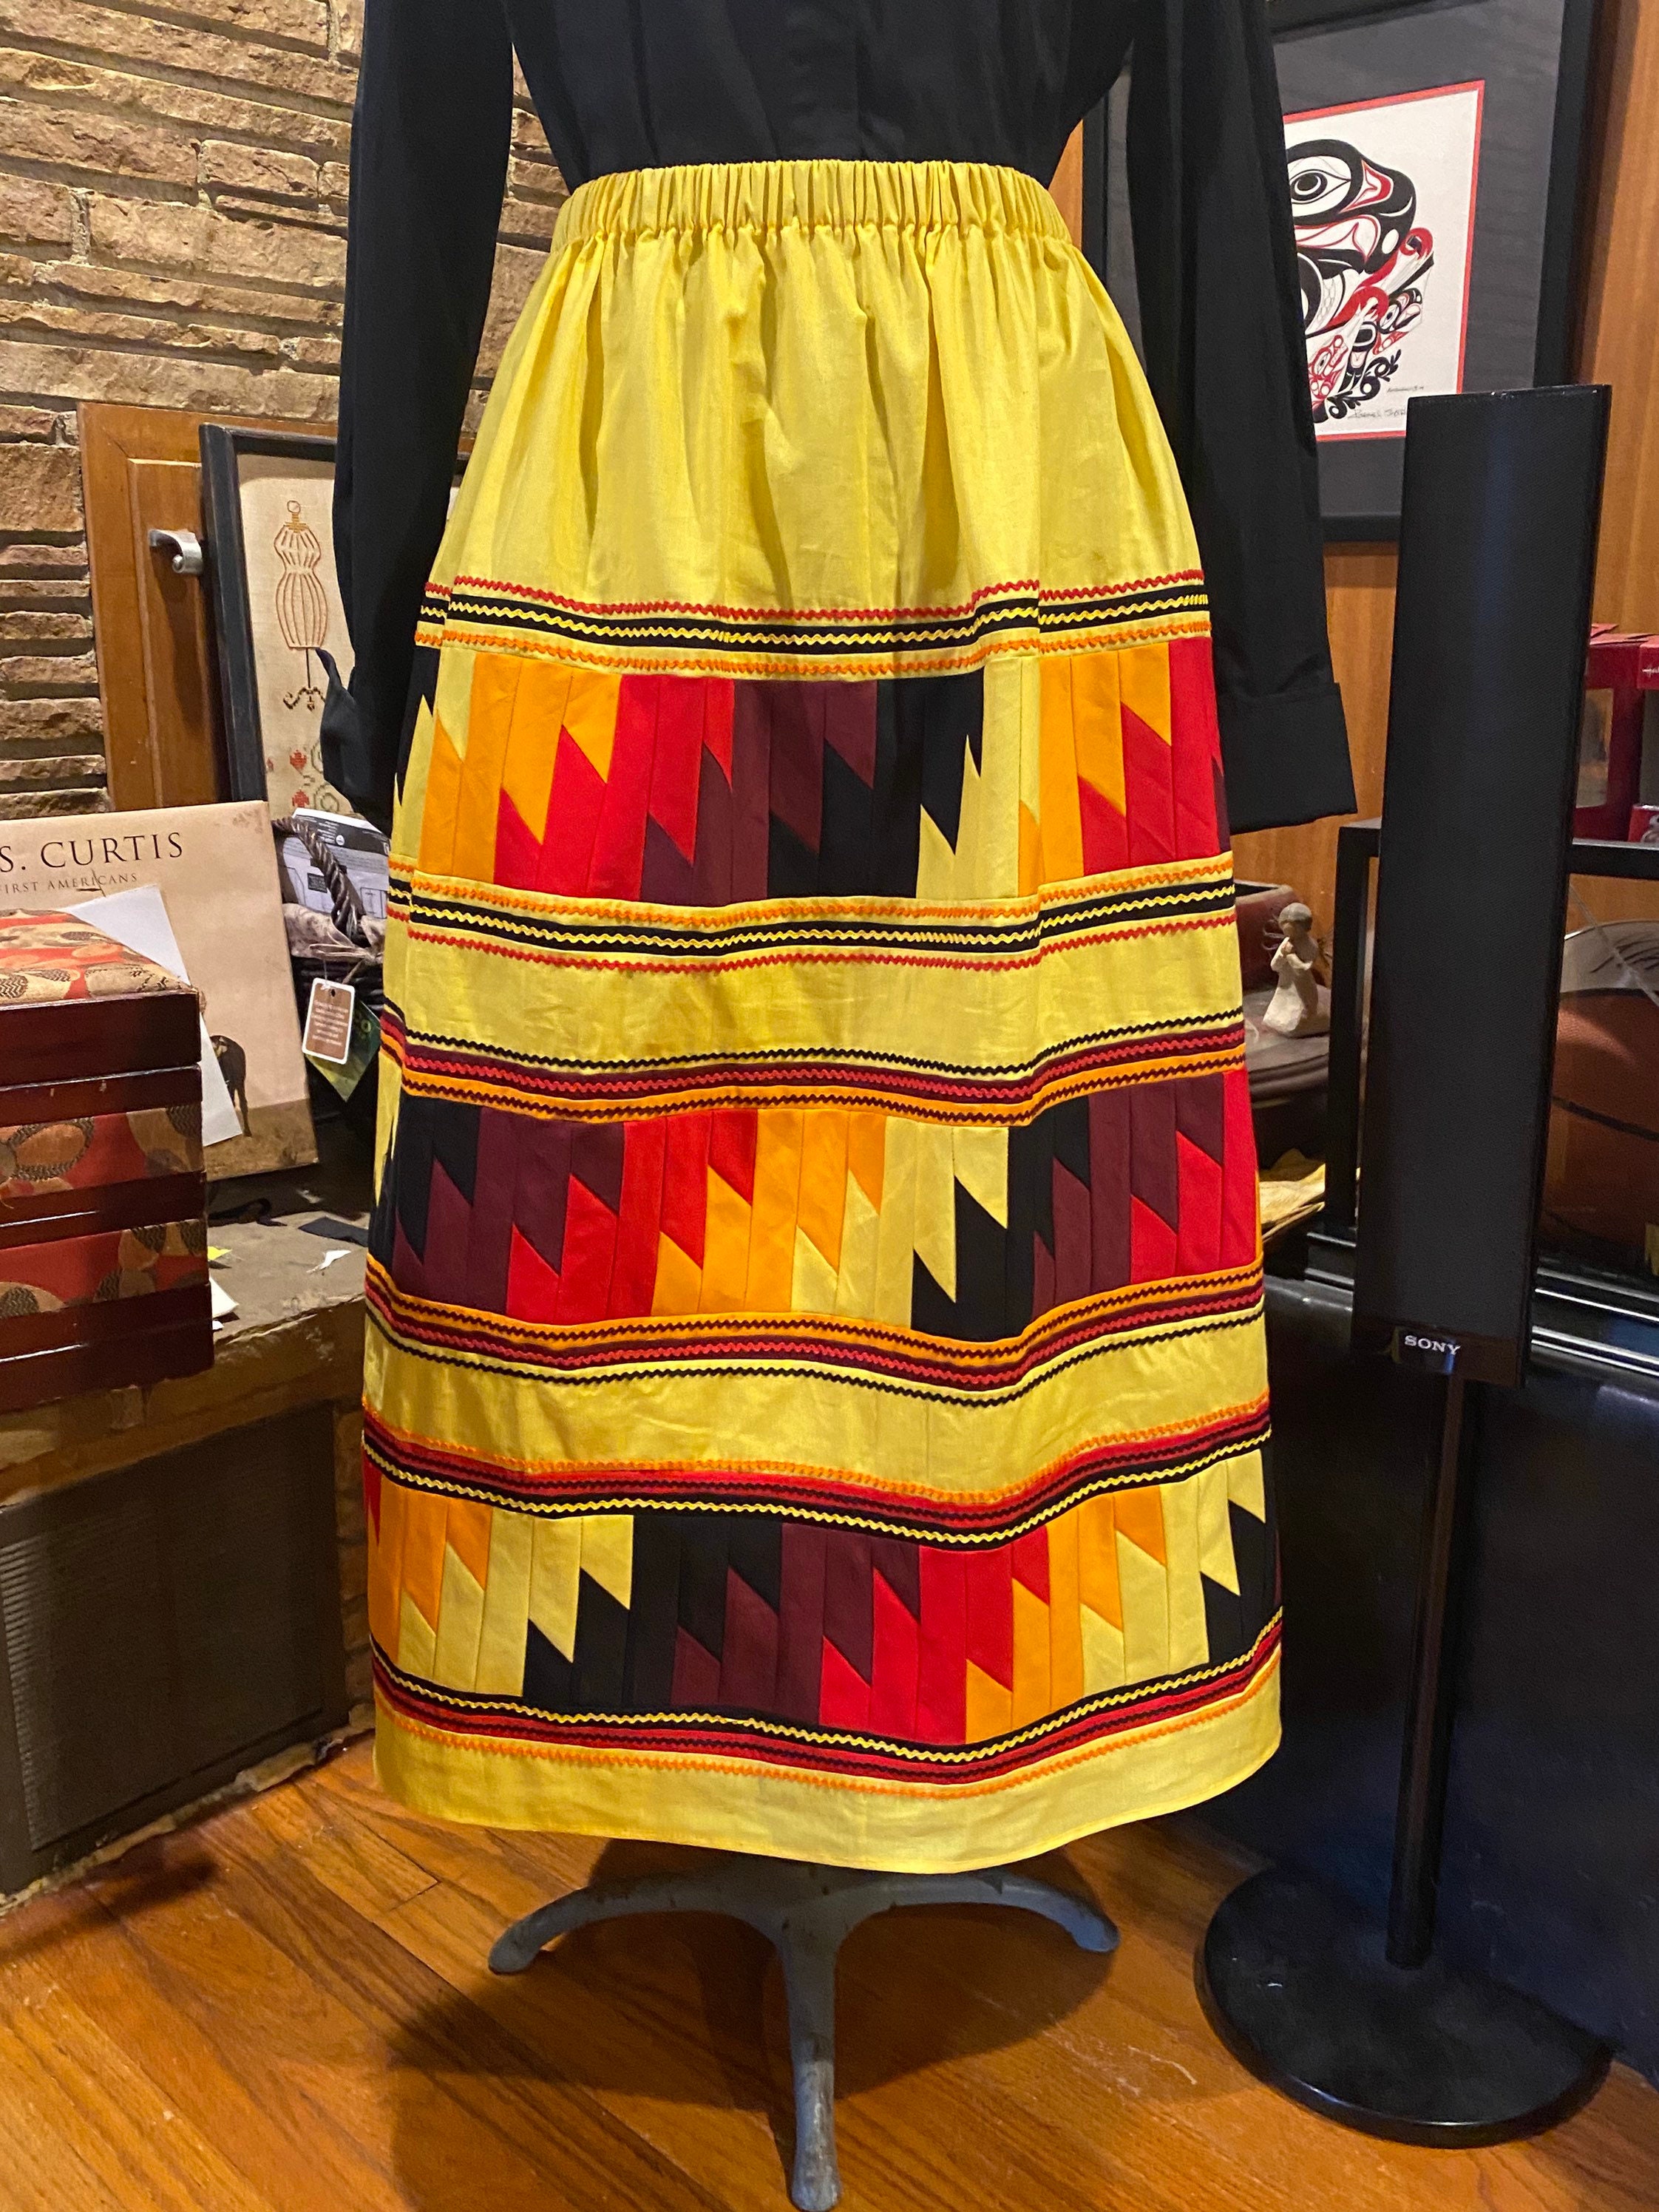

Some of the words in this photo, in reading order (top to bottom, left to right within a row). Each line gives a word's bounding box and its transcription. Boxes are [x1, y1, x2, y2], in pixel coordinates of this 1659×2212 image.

[0, 846, 26, 872] S.
[41, 832, 183, 868] CURTIS
[0, 881, 38, 894] IRST
[47, 872, 138, 890] AMERICANS
[1405, 1334, 1461, 1355] SONY
